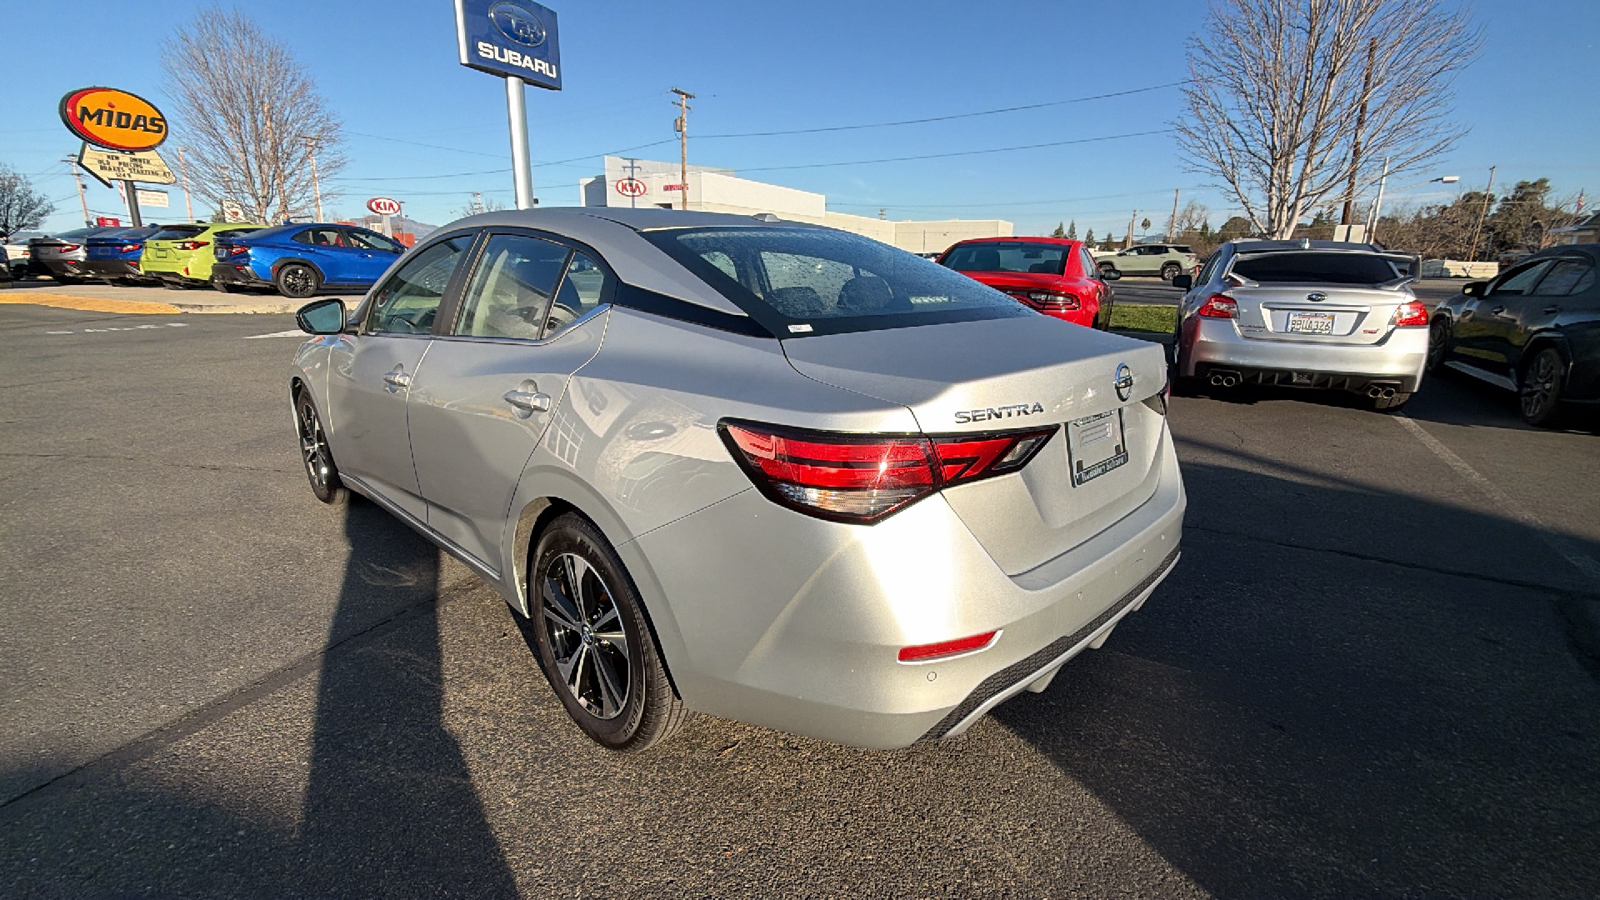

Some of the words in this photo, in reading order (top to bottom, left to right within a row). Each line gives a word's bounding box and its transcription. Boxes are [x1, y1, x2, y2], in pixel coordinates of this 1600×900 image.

[478, 41, 557, 79] SUBARU
[79, 102, 165, 134] MIDAS
[374, 201, 396, 212] KIA
[954, 402, 1044, 424] SENTRA
